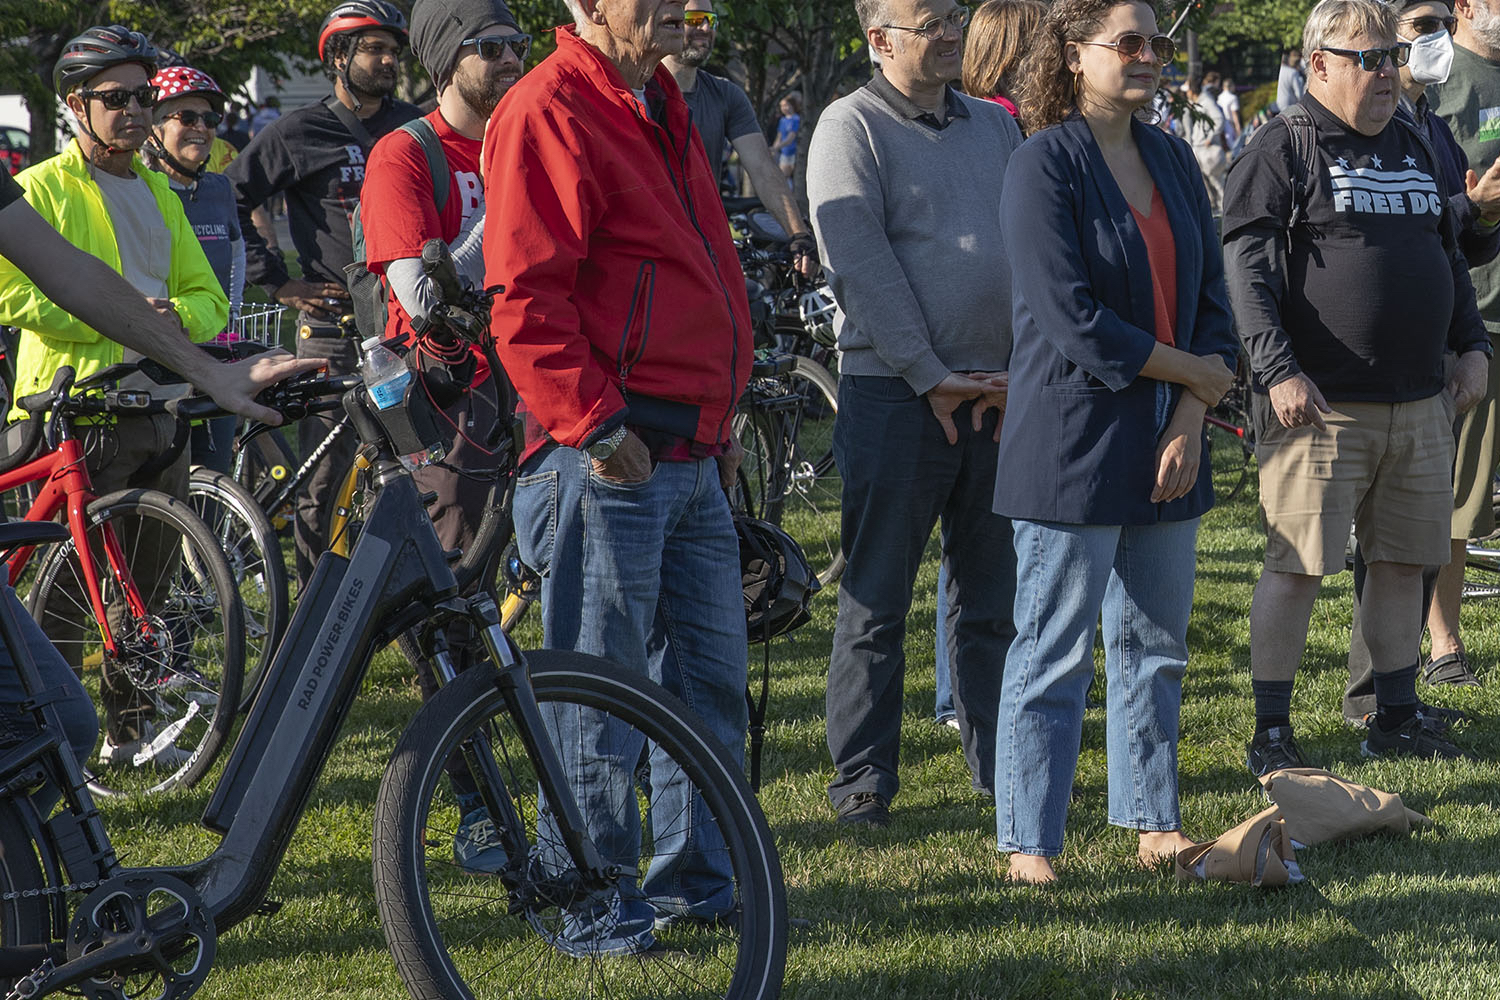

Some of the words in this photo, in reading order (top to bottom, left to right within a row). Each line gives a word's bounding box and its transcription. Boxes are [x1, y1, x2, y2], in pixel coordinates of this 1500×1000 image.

[1333, 189, 1406, 215] FREE
[1408, 191, 1442, 217] DC
[297, 677, 319, 711] RAD
[312, 622, 344, 678] POWER
[338, 578, 364, 621] BIKES
